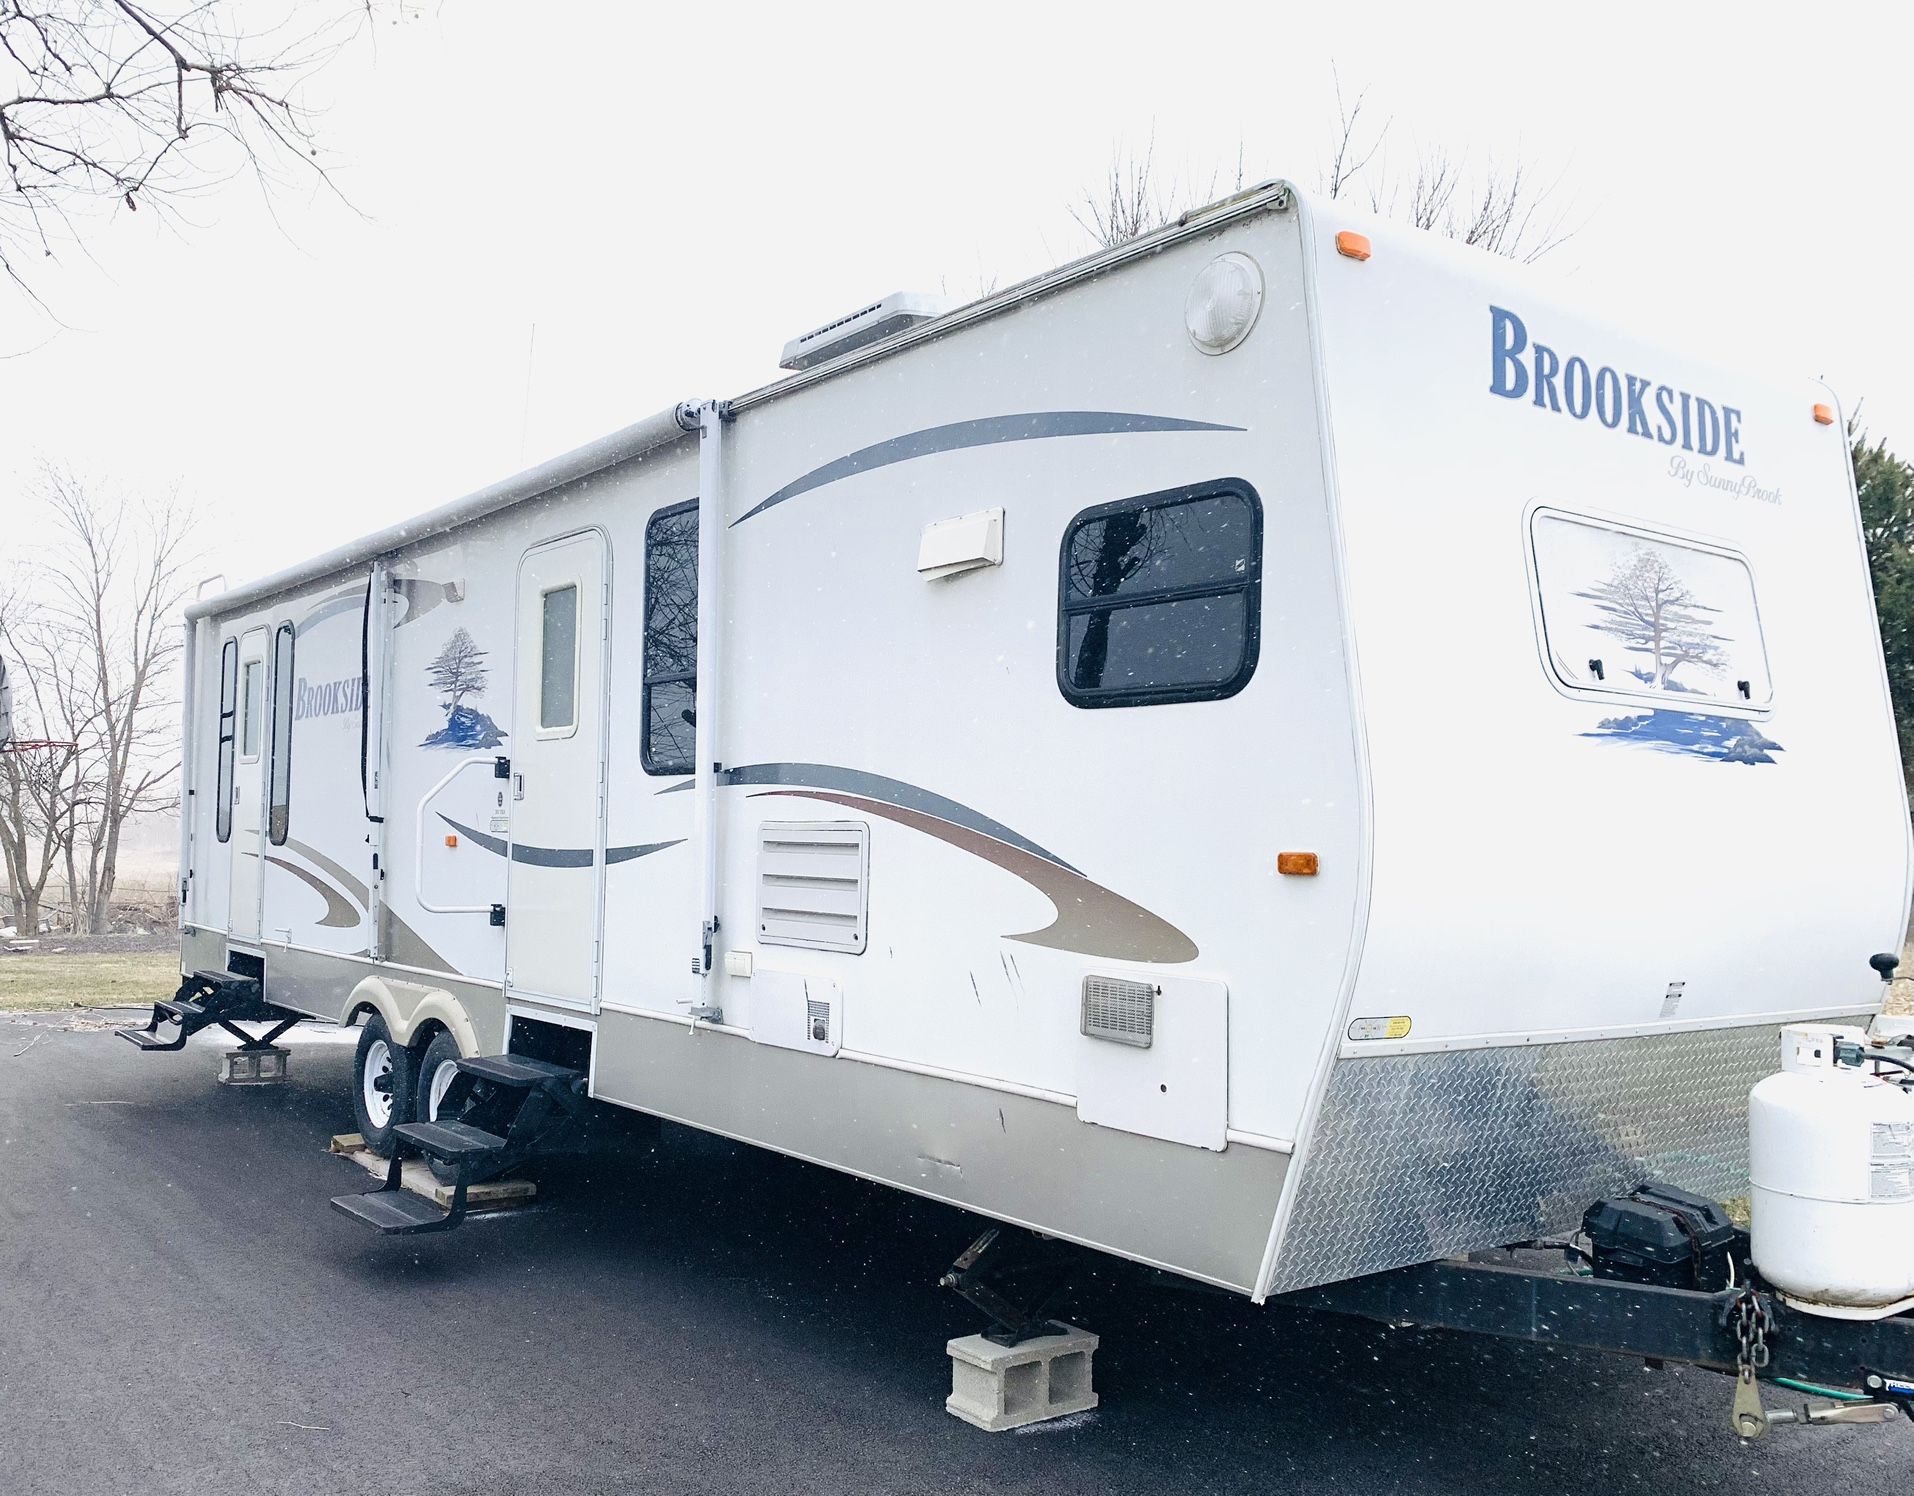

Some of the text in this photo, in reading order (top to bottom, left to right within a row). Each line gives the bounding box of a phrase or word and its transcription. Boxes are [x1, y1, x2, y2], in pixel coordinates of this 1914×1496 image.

[1489, 304, 1745, 466] BROOKSIDE
[1667, 455, 1782, 506] By SunnyBrook
[294, 677, 371, 721] BROOKSID
